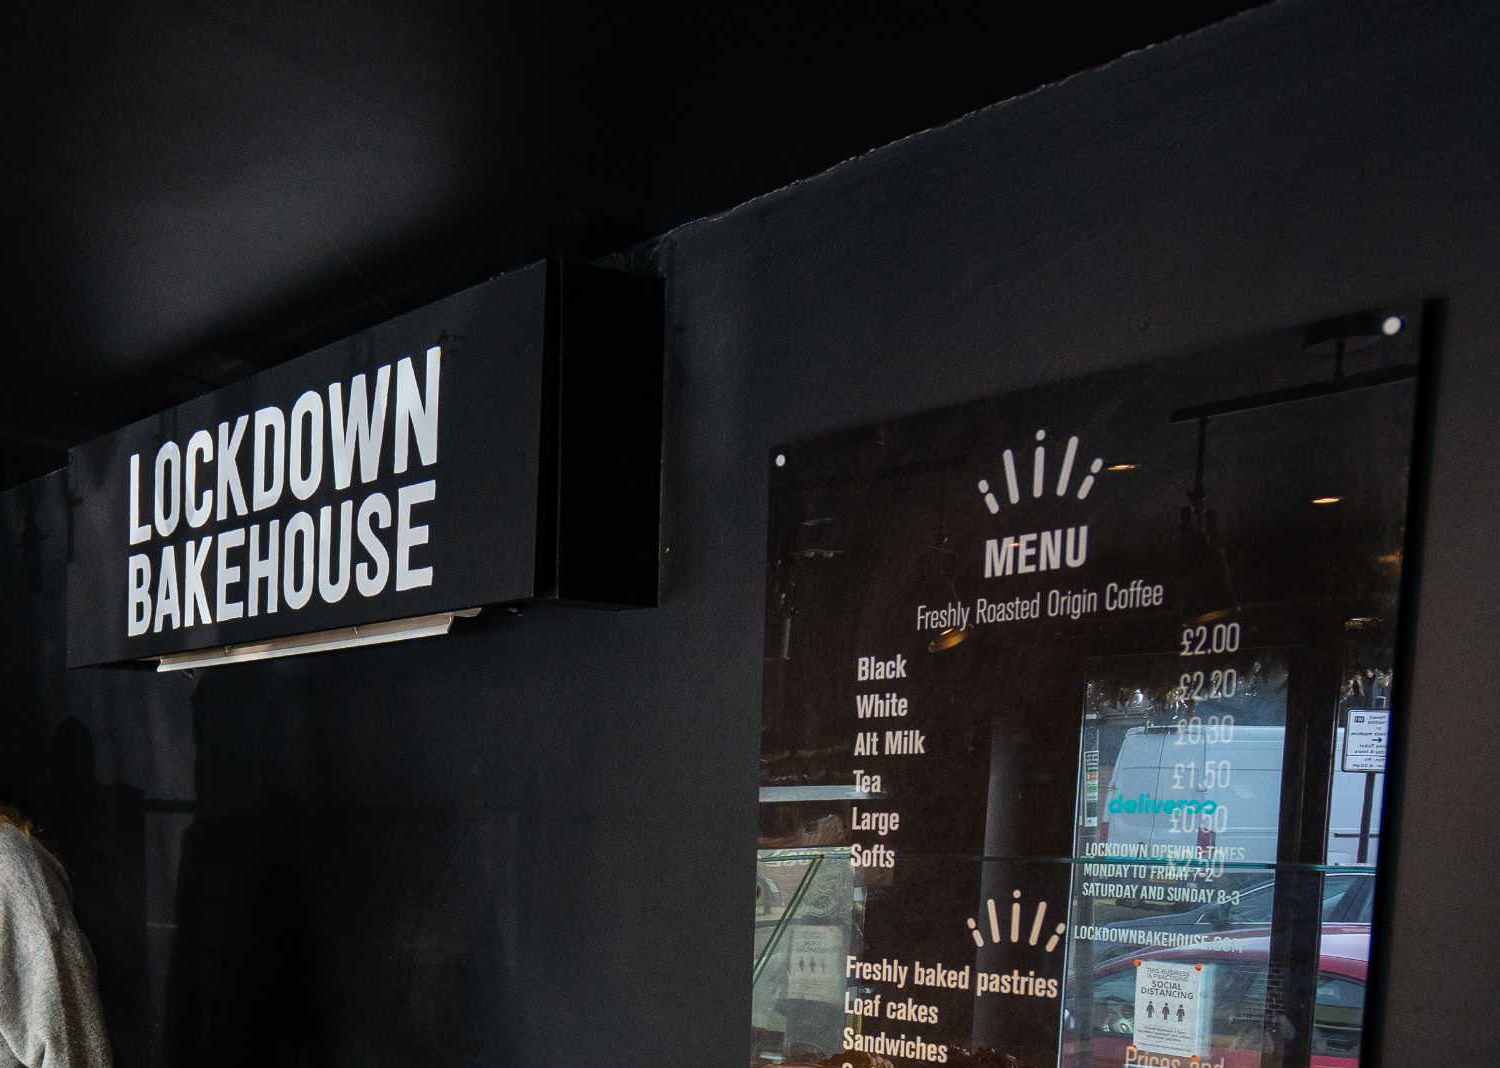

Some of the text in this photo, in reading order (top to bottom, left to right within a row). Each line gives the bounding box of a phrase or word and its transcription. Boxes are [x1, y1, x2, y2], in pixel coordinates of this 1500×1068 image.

[129, 346, 441, 545] LOCKDOWN
[128, 479, 436, 637] BAKEHOUSE
[984, 526, 1088, 579] MENU
[916, 580, 1164, 631] Freshly Roasted Origin Coffee
[1179, 622, 1240, 656] £2.00
[857, 654, 908, 682] Black
[1179, 669, 1236, 701] £2.20
[856, 693, 908, 719] White
[854, 730, 925, 757] Alt Milk
[852, 770, 882, 794] Tea
[1172, 760, 1230, 790] £1.50
[851, 808, 900, 834] Large
[850, 843, 895, 869] Softs
[1085, 843, 1147, 857] LOCKDOWN
[1084, 864, 1132, 878] MONDAY
[1134, 866, 1146, 879] TO
[1150, 865, 1190, 880] FRIDAY
[1083, 882, 1240, 905] SATURDAY AND SUNDAY 8-3
[845, 956, 1058, 1000] Freshly baked pastries
[1152, 980, 1182, 990] SOCIAL
[1141, 987, 1194, 999] DISTANCING
[844, 992, 939, 1025] Loaf cakes
[842, 1027, 948, 1064] Sandwiches
